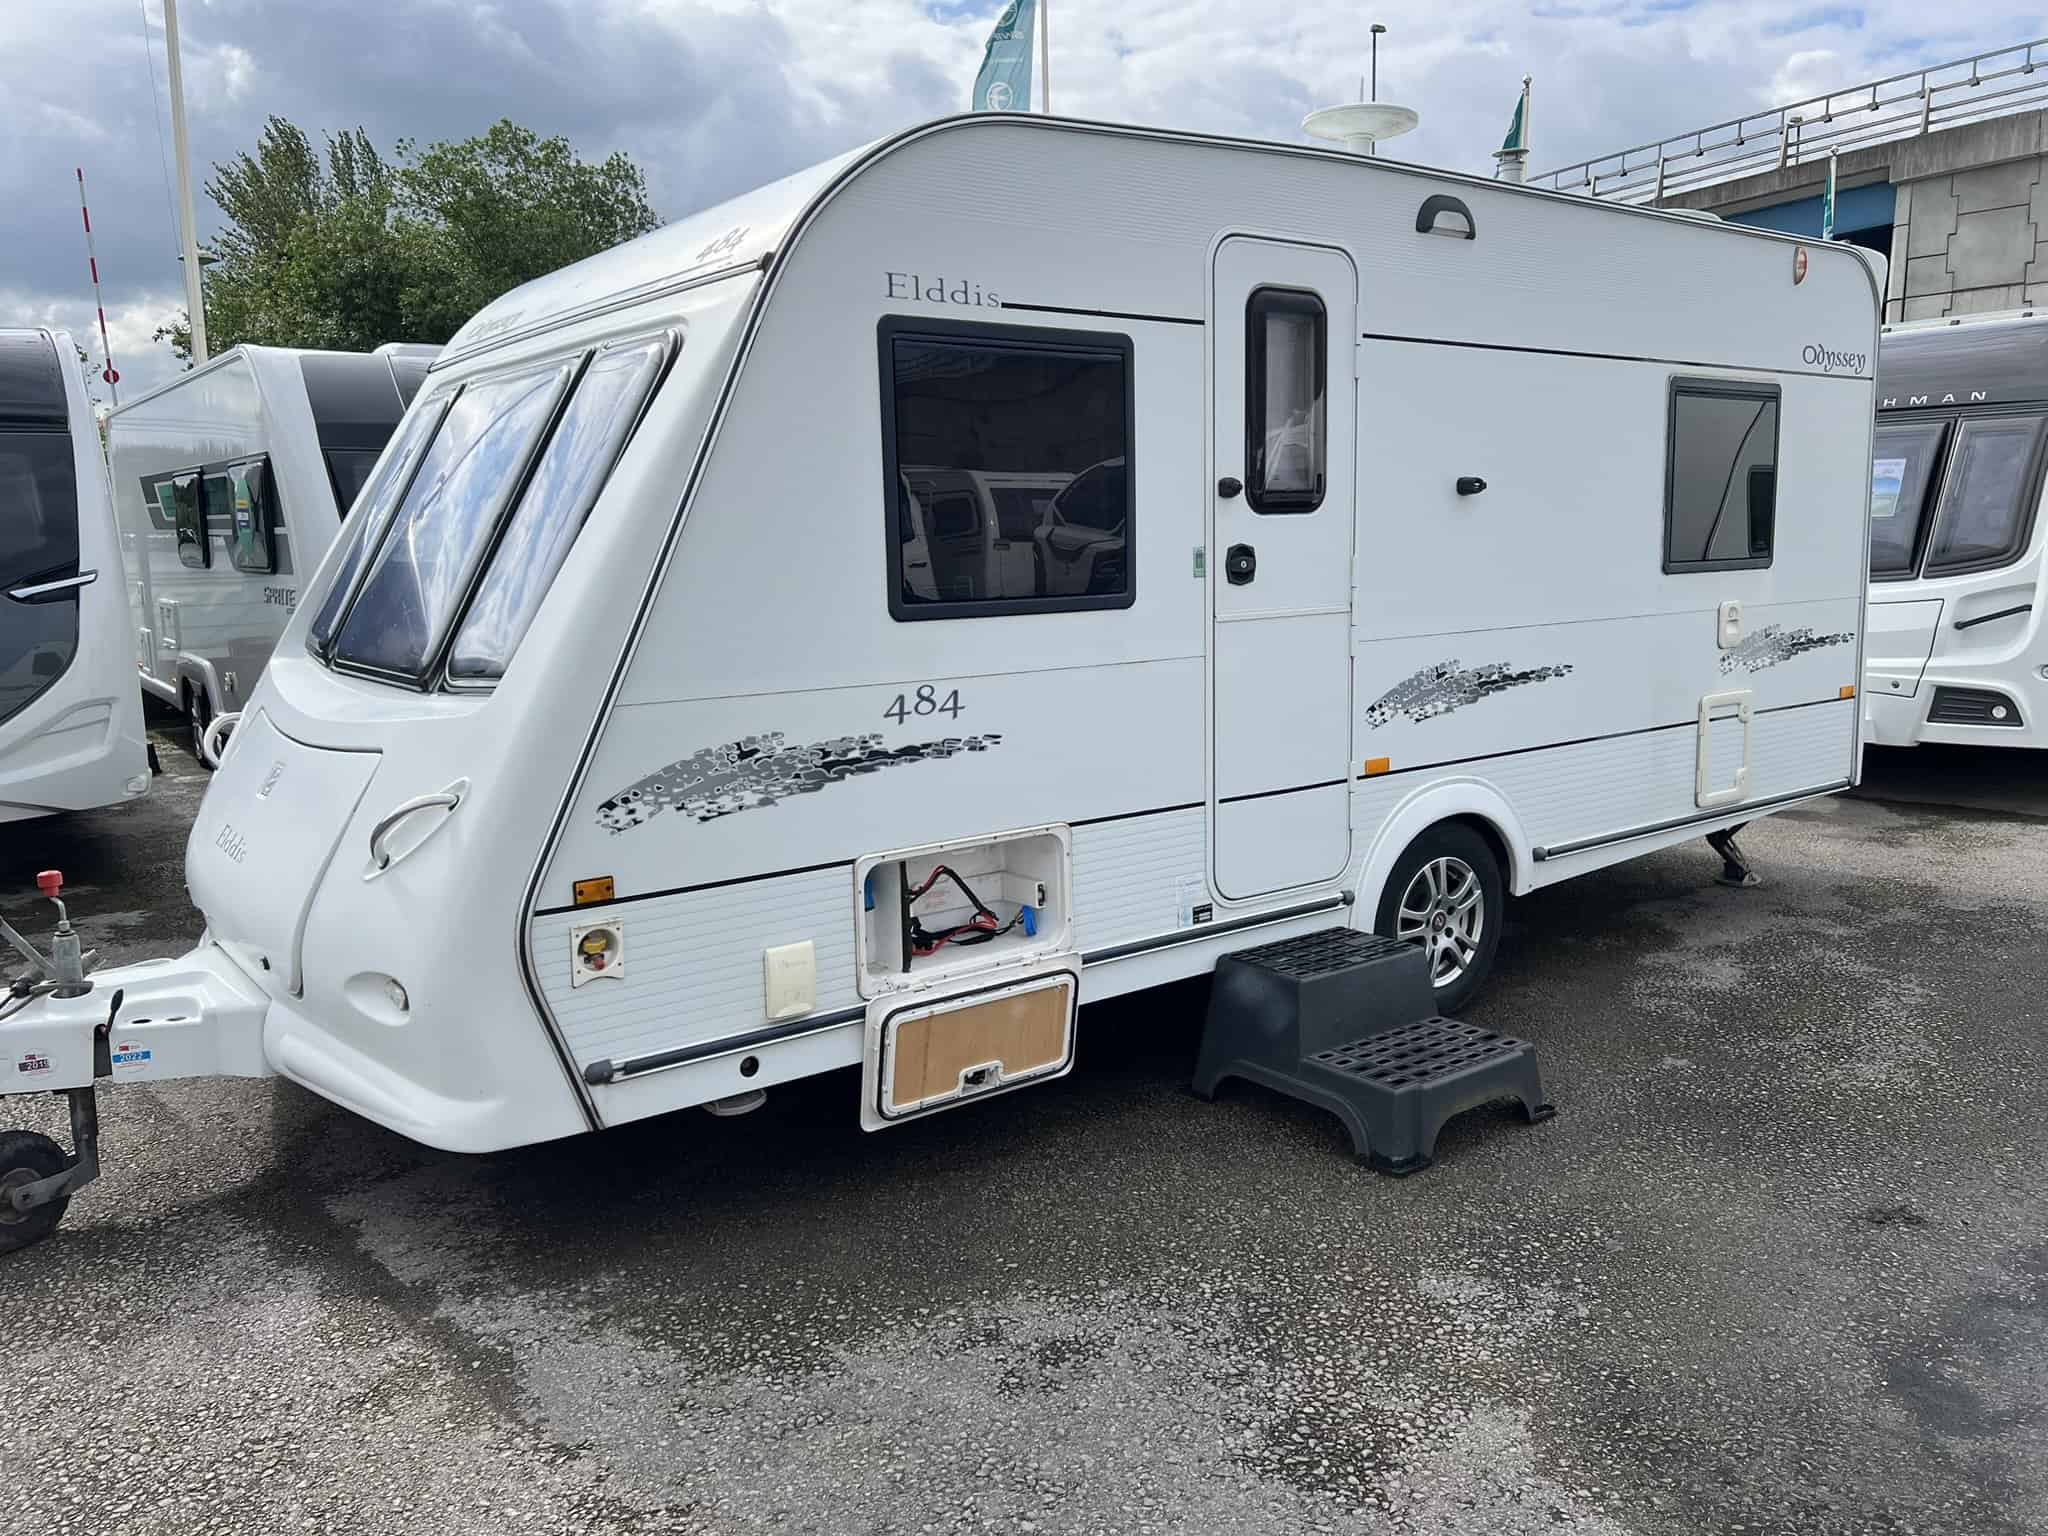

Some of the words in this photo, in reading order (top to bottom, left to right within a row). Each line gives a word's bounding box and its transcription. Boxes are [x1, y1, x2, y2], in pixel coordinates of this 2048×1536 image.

[884, 271, 1000, 308] Elddis
[1802, 343, 1866, 375] Odyssey
[883, 684, 966, 726] 484
